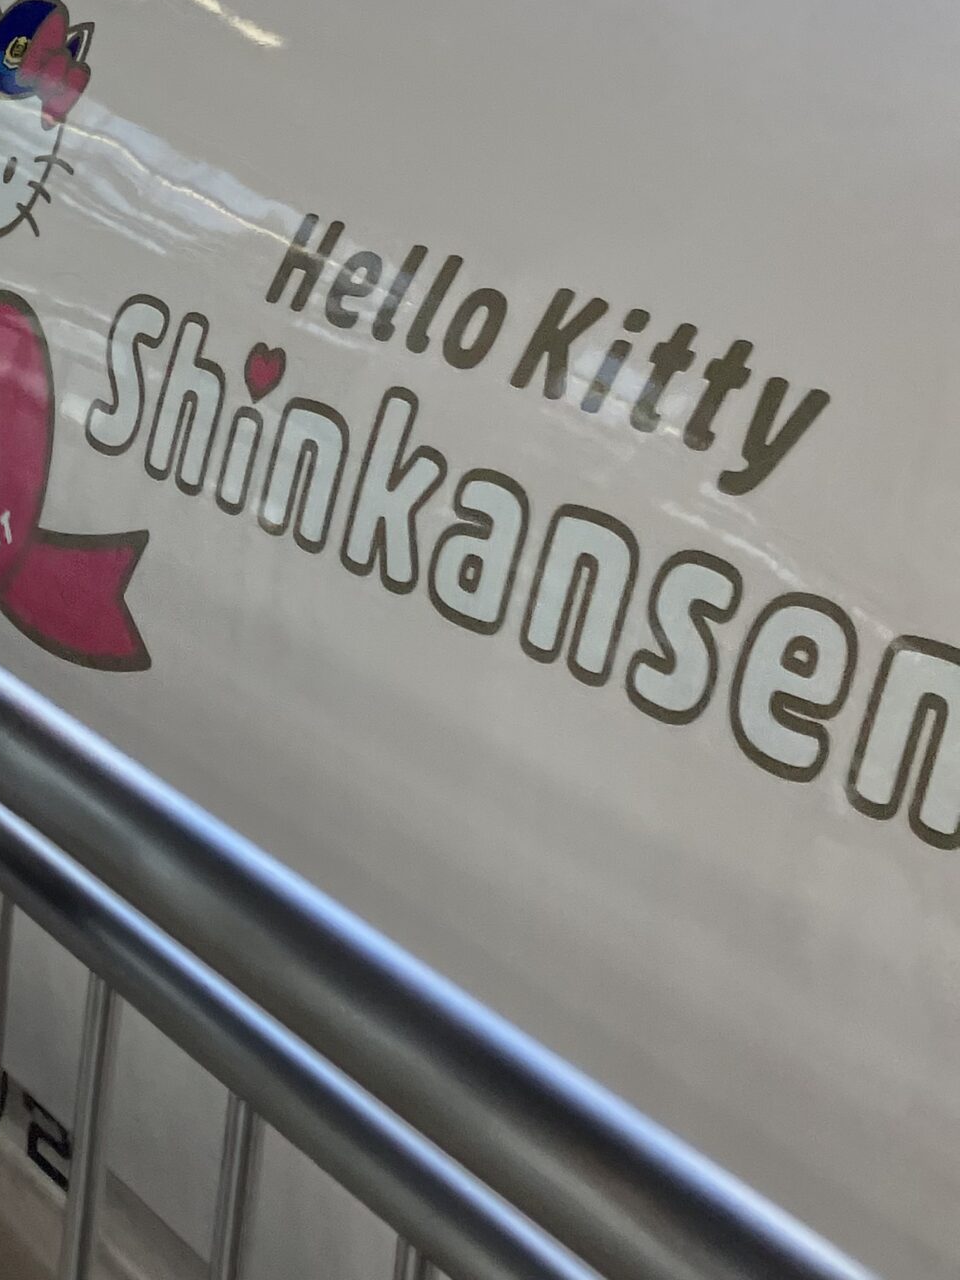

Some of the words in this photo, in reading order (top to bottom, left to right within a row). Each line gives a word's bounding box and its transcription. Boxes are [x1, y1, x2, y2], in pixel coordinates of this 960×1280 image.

[266, 213, 508, 370] Hello
[510, 288, 830, 496] Kitty
[85, 293, 960, 851] Shinkansen
